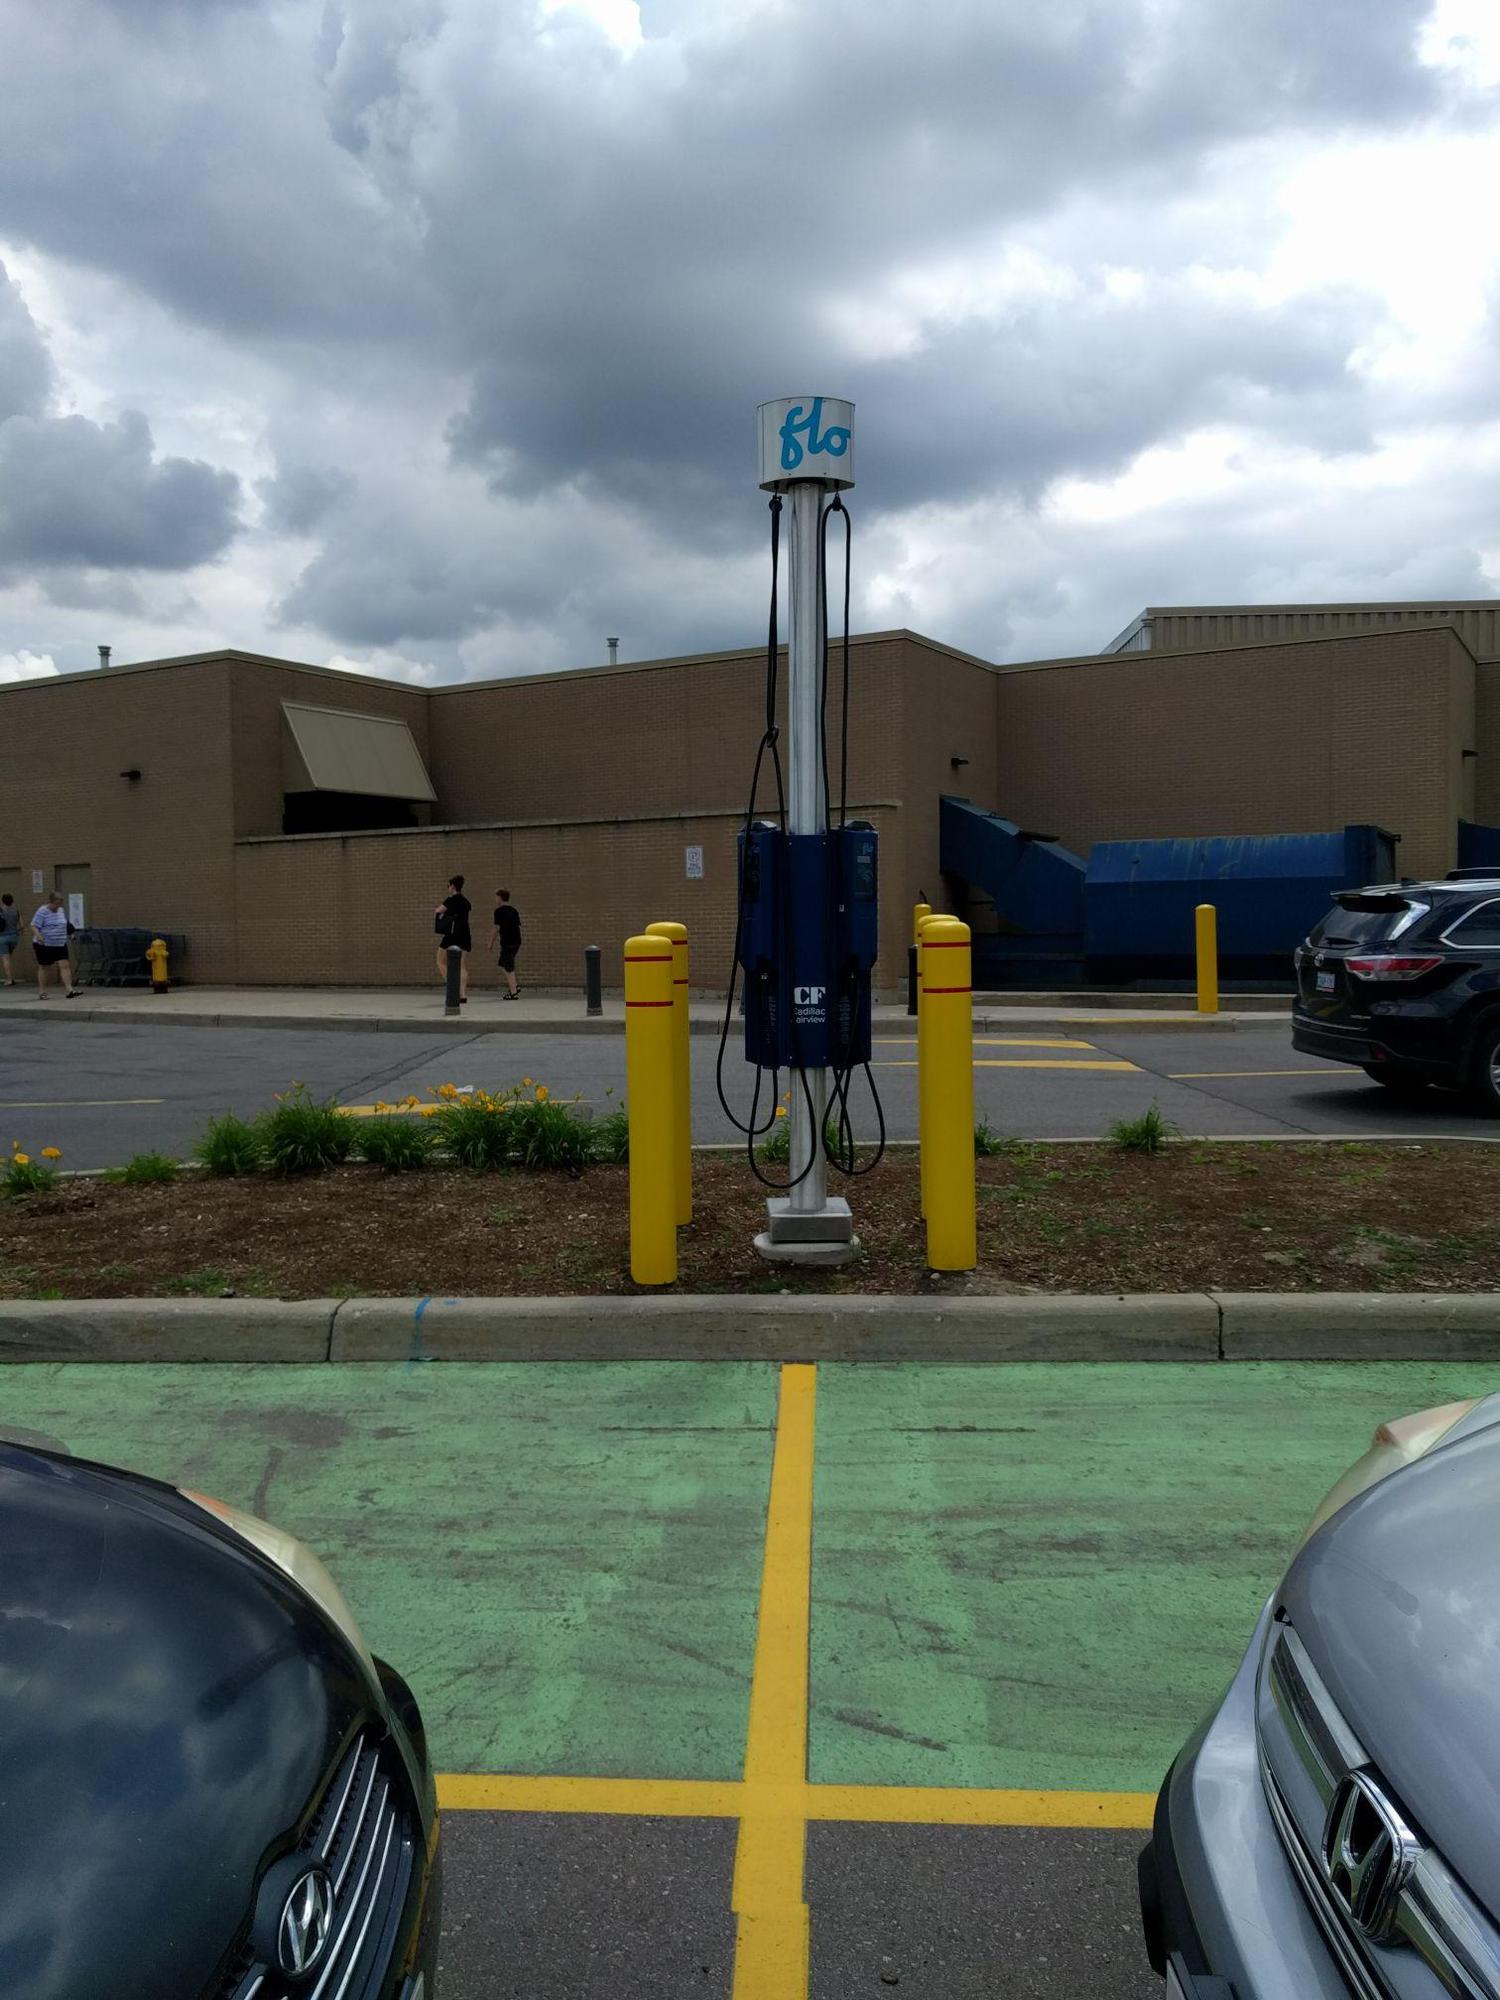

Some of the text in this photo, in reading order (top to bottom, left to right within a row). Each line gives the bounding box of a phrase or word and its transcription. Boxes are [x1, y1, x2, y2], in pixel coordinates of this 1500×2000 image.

[779, 397, 851, 470] flo
[794, 986, 826, 1005] CF
[794, 1015, 826, 1024] airview
